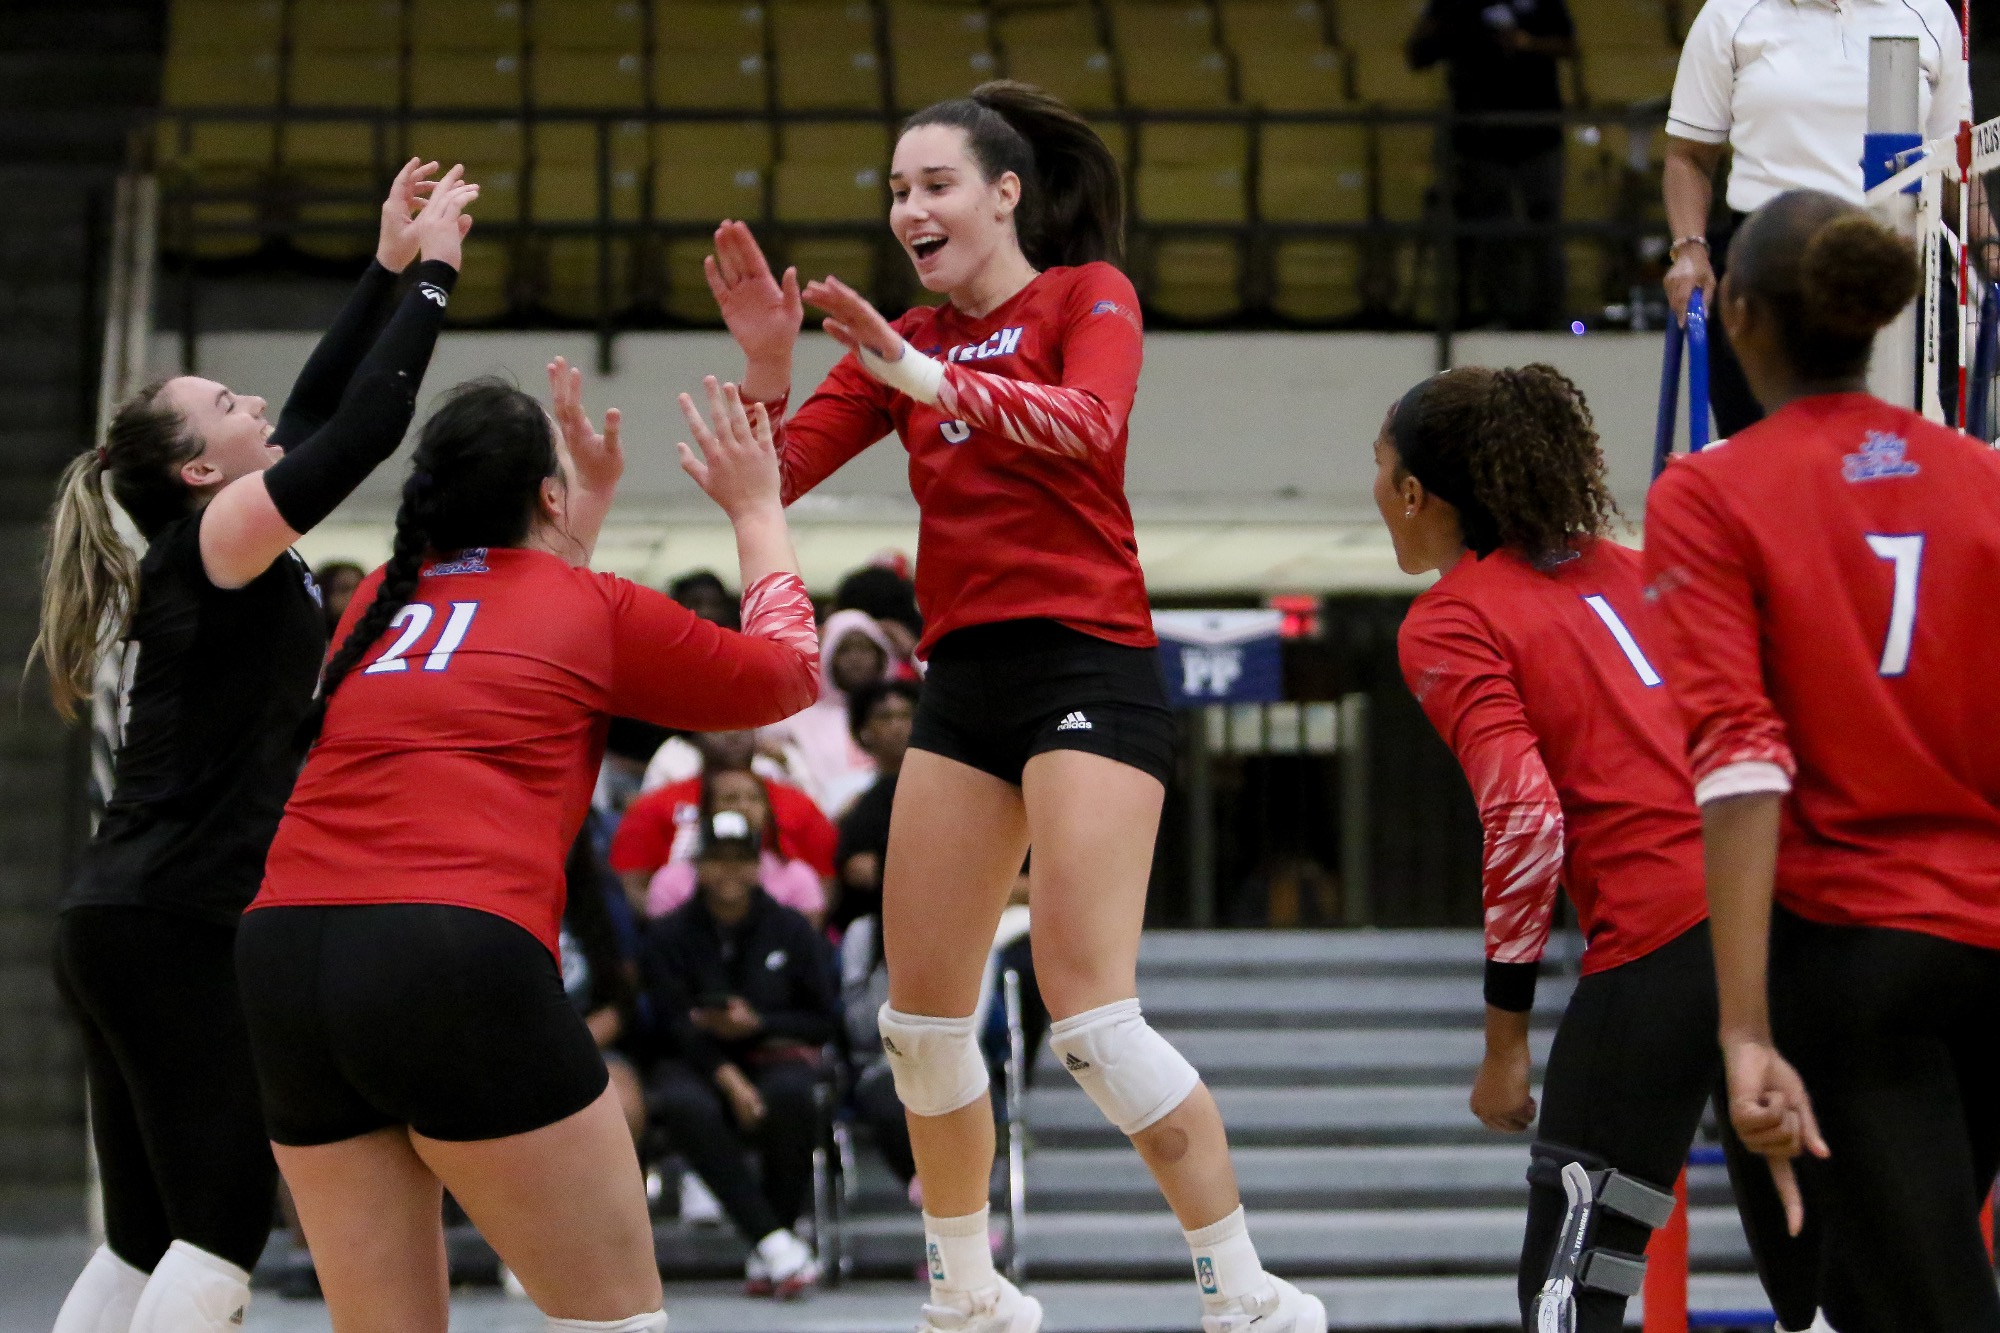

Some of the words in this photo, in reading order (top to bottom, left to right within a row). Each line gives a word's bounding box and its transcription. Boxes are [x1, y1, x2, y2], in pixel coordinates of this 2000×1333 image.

[361, 600, 480, 676] 21
[1580, 594, 1663, 687] 1
[1864, 533, 1925, 678] 7
